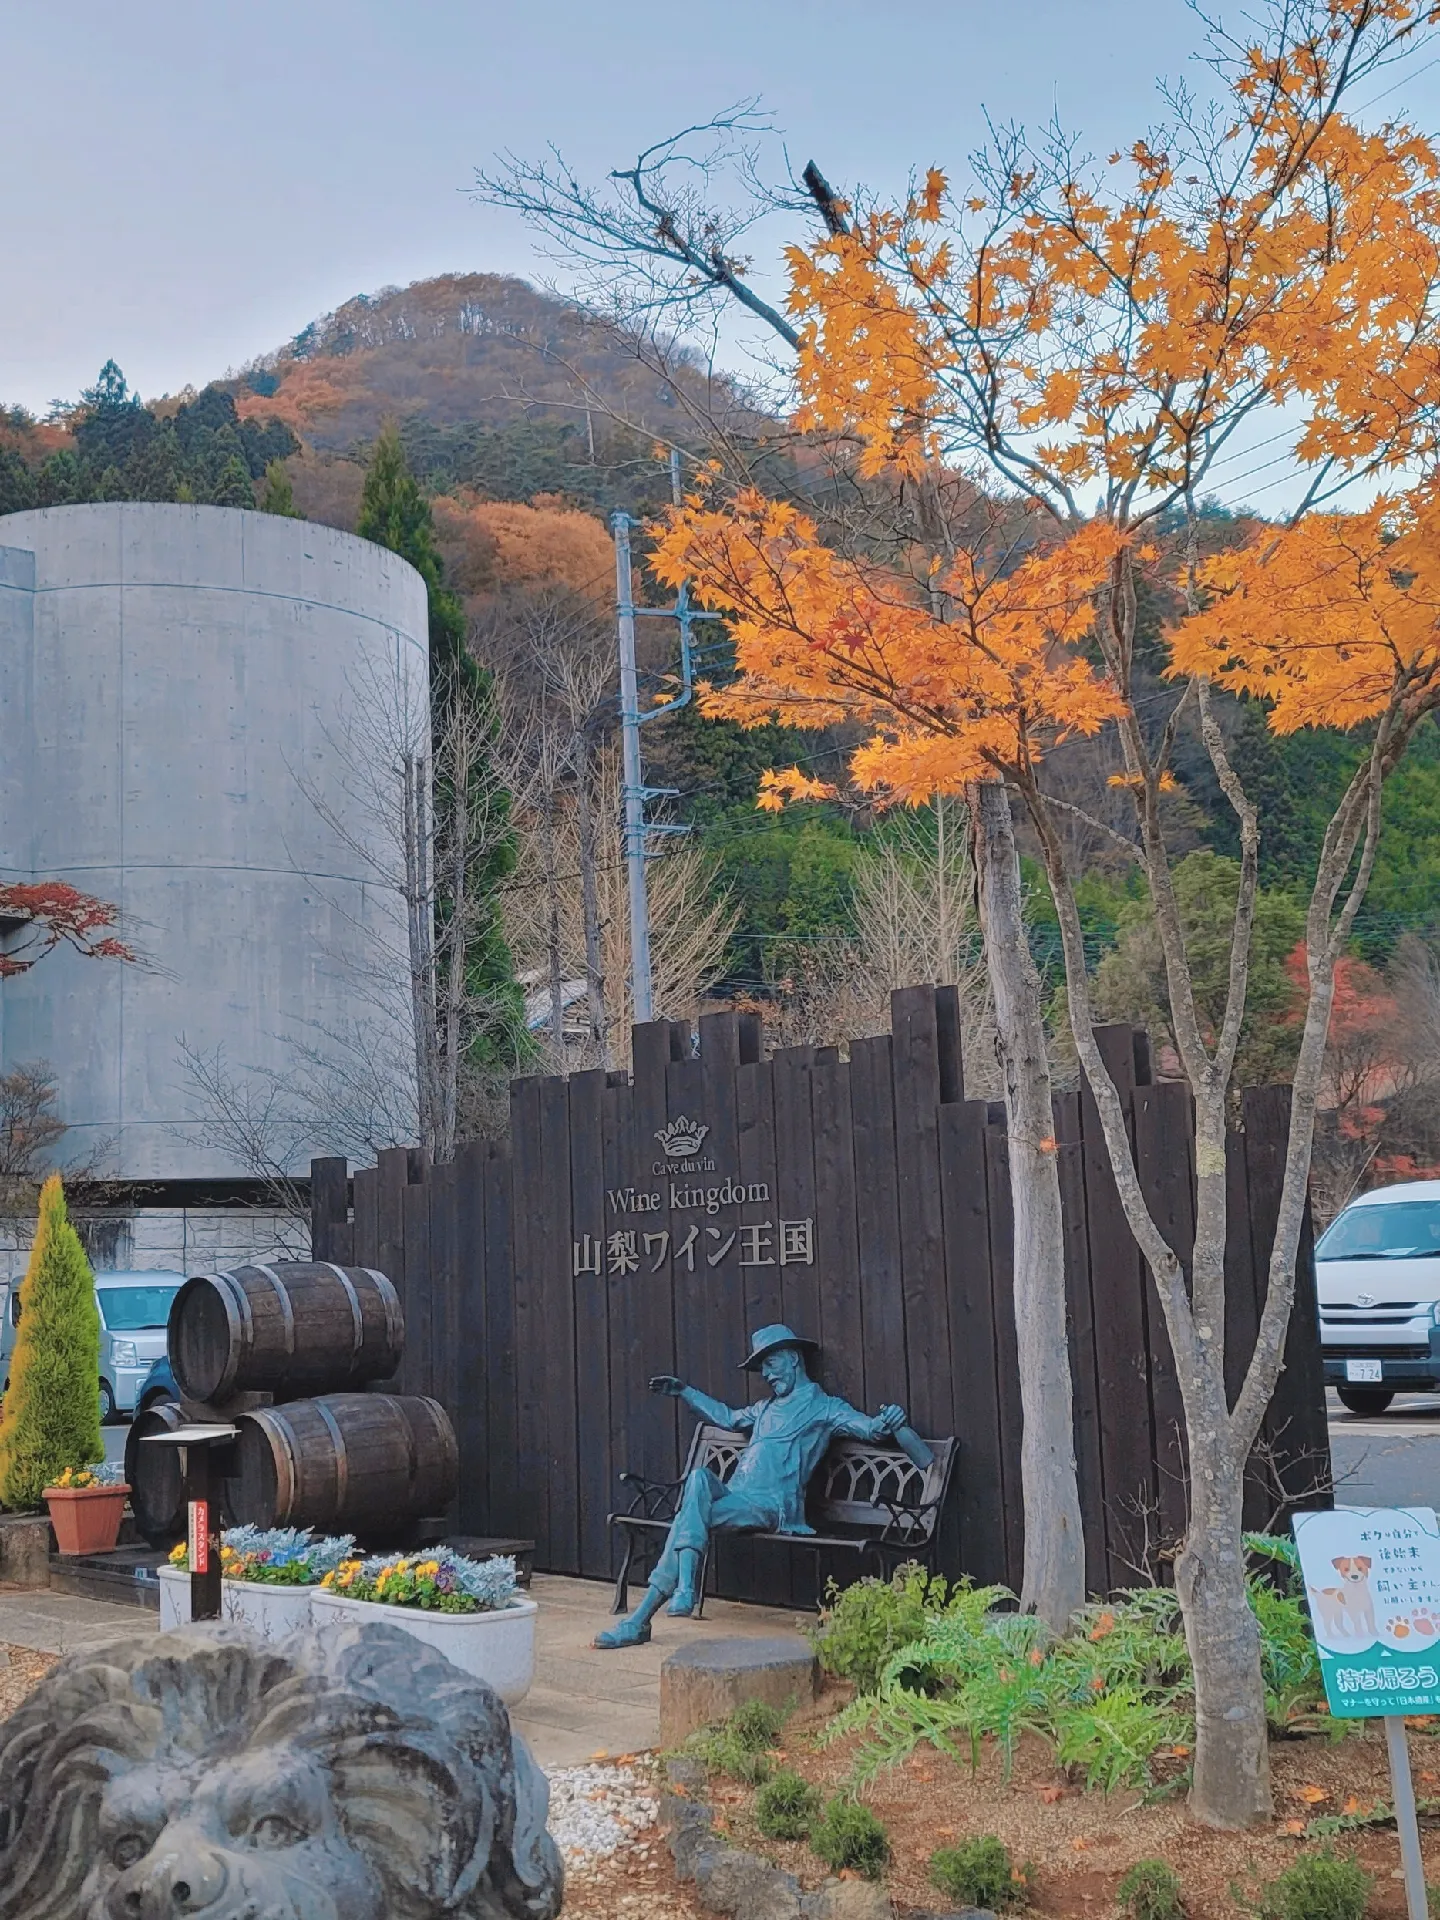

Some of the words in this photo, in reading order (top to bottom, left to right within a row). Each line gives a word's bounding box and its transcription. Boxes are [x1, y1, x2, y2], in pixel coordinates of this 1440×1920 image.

[652, 1161, 679, 1176] Cave
[680, 1157, 695, 1173] du
[696, 1156, 716, 1171] vin
[607, 1187, 661, 1214] Wine
[669, 1176, 770, 1215] kingdom
[573, 1216, 815, 1277] 山梨ワイン王国
[1336, 1666, 1438, 1692] 持ち帰ろう
